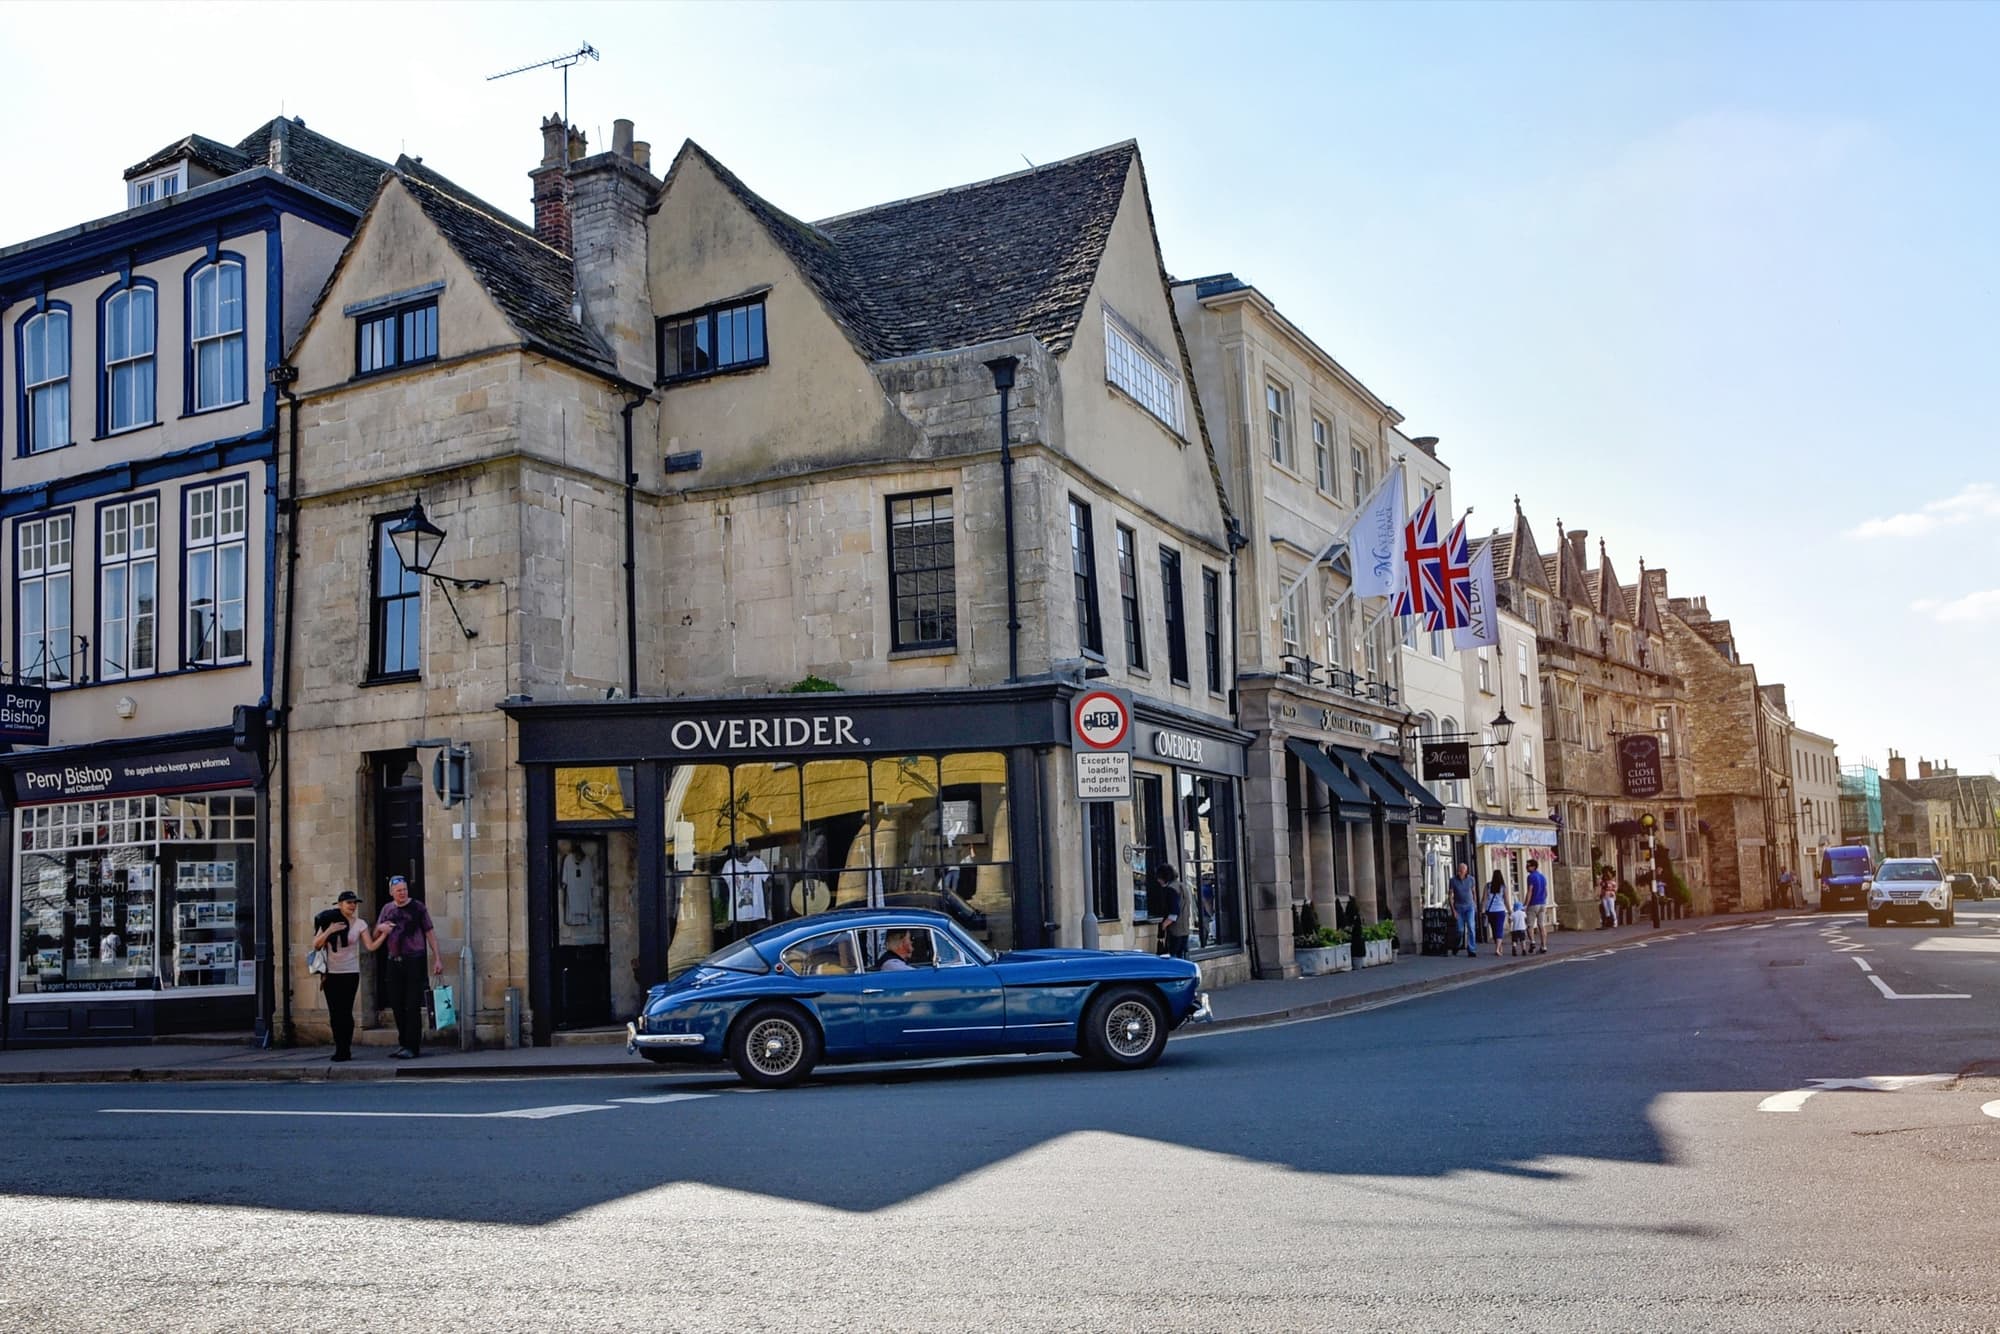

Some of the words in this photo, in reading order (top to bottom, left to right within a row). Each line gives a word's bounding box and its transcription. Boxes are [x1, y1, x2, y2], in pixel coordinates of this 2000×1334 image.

[1470, 578, 1486, 639] AVEDA
[7, 694, 41, 713] Perry
[1, 708, 46, 728] Bishop
[1081, 756, 1110, 766] Except
[1112, 756, 1125, 764] for
[124, 768, 135, 776] the
[136, 766, 153, 776] agent
[154, 764, 168, 773] who
[168, 763, 188, 773] keeps
[188, 762, 201, 771] you
[201, 757, 231, 768] informed
[1088, 766, 1119, 774] loading
[26, 772, 62, 790] Perry
[65, 765, 112, 786] Bishop
[1627, 768, 1655, 777] CLOSE
[1081, 776, 1097, 784] and
[1099, 776, 1127, 785] permit
[1628, 776, 1656, 786] HOTEL
[76, 784, 105, 792] Chambers
[1088, 785, 1120, 793] holders
